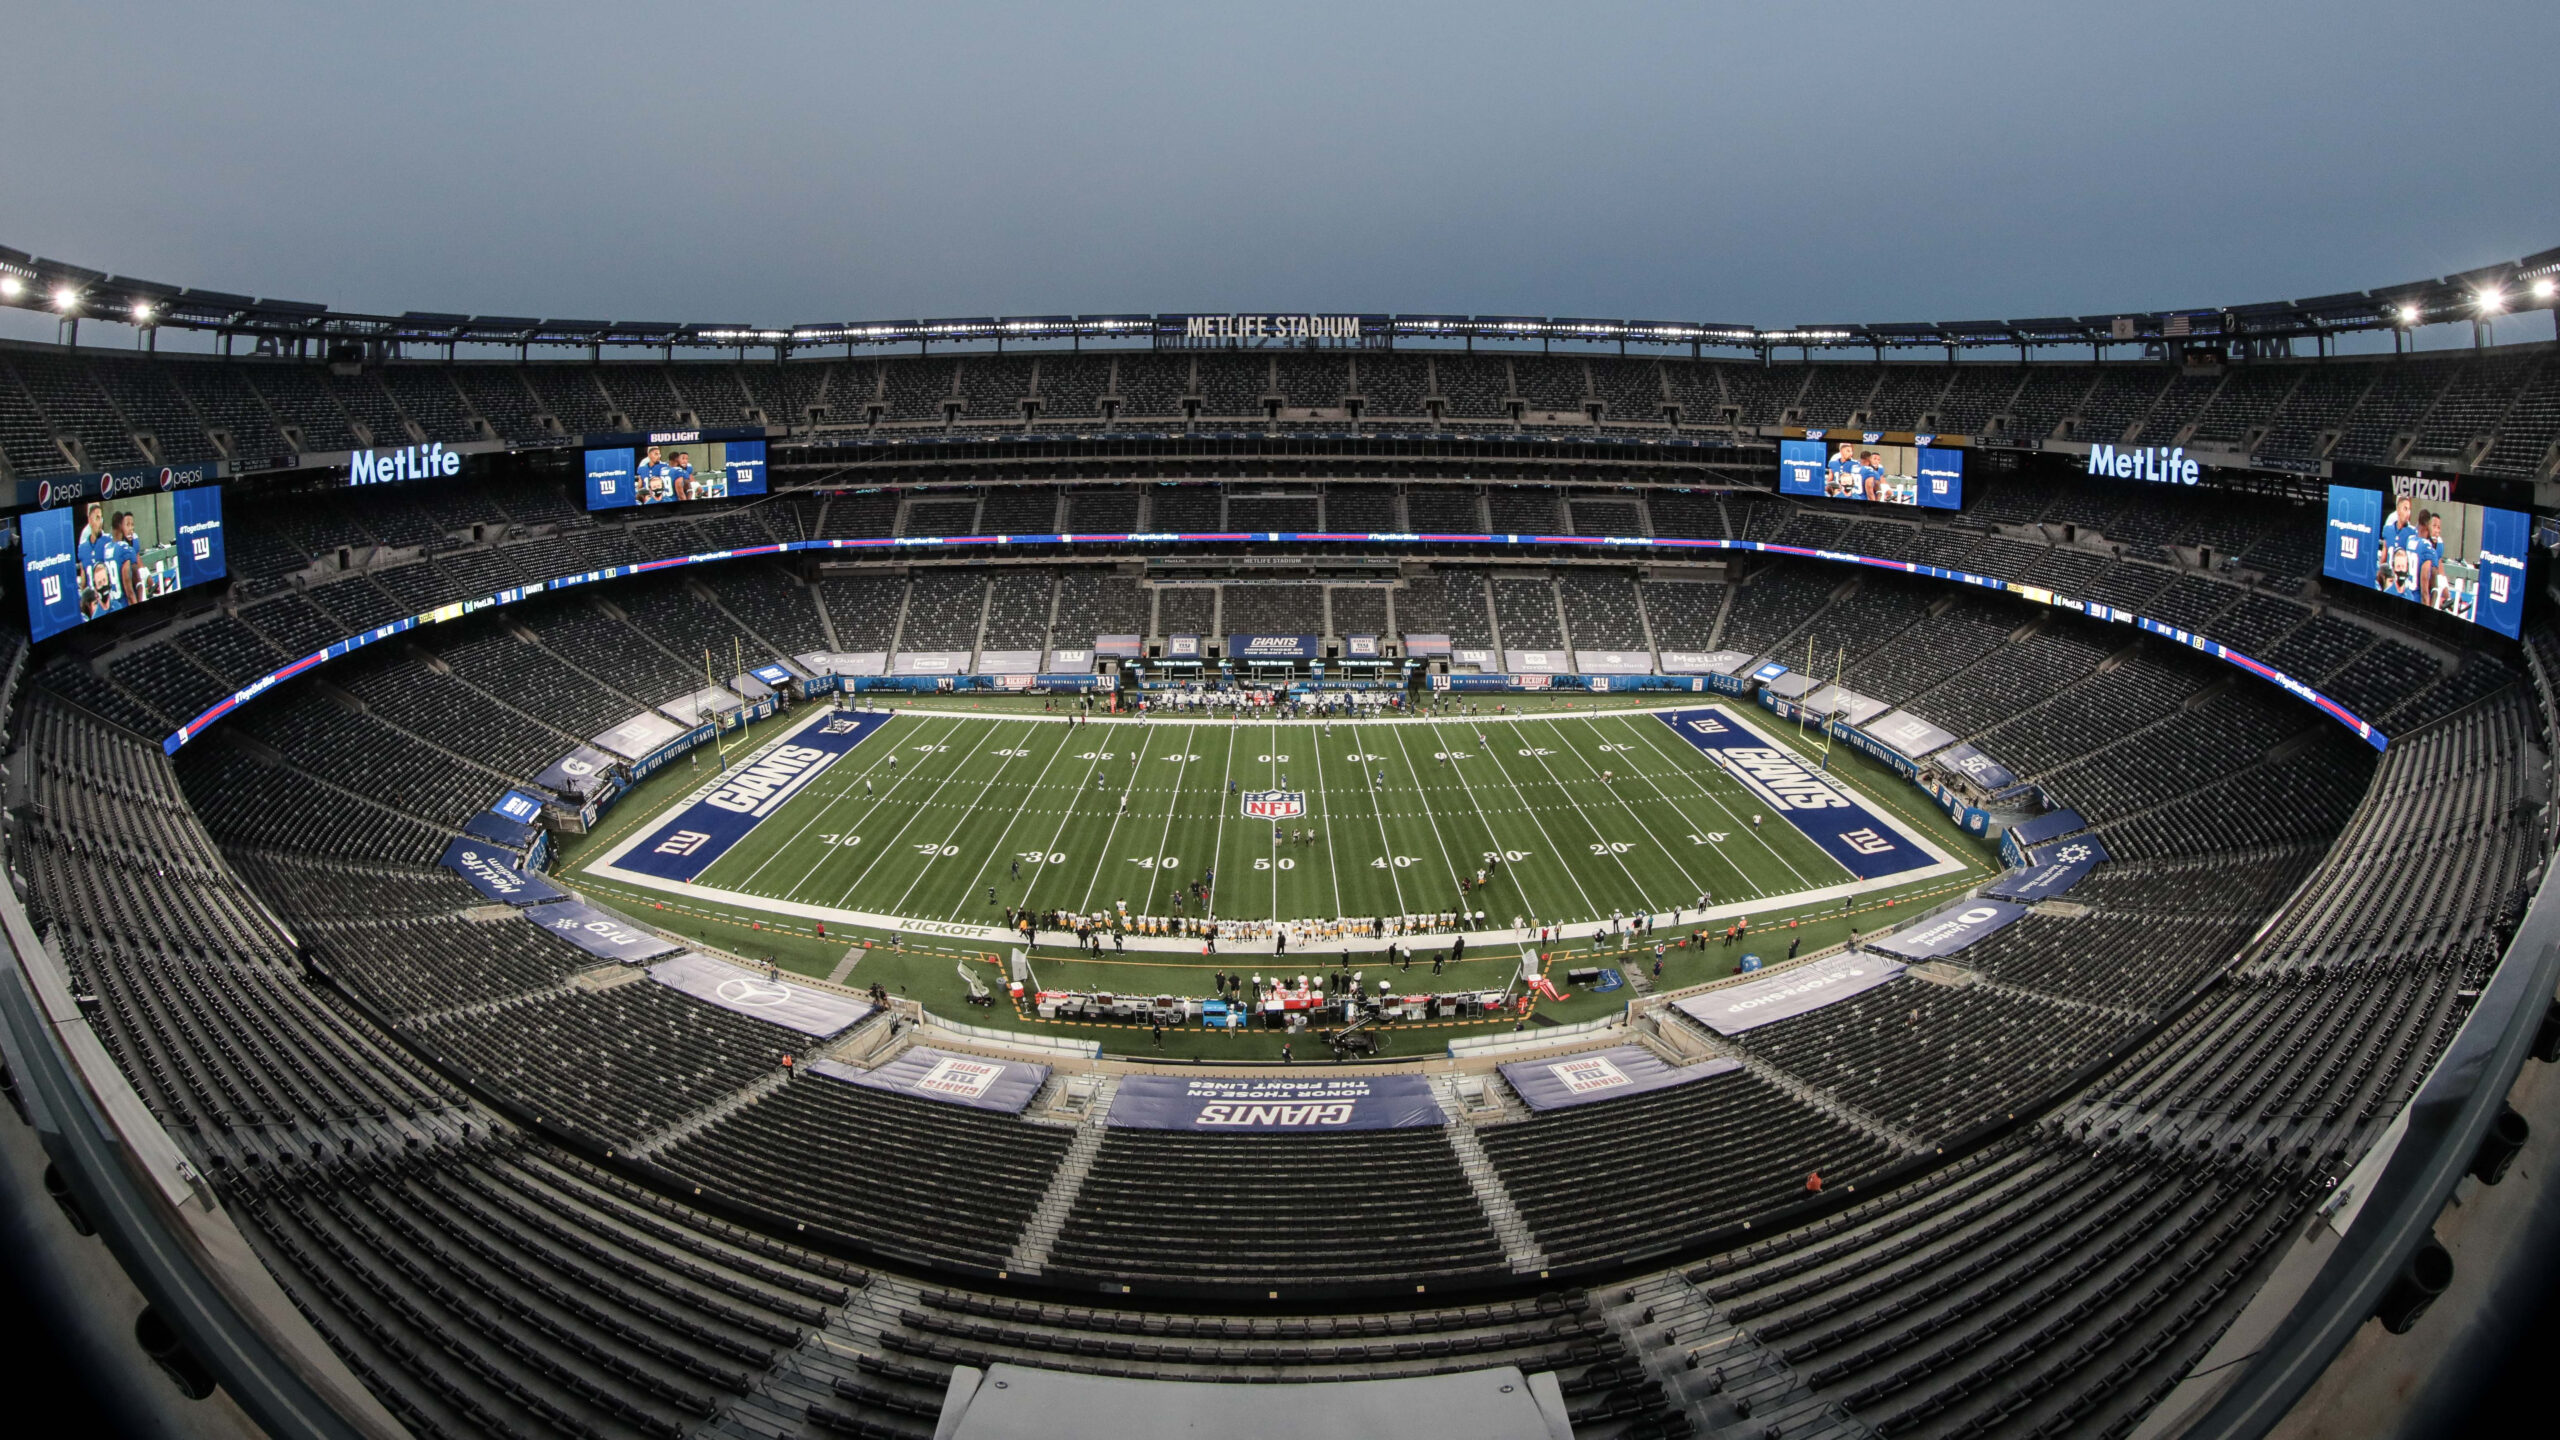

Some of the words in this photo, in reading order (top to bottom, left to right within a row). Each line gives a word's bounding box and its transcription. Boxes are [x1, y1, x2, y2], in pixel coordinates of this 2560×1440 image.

[1187, 316, 1268, 338] METLIFE
[1275, 316, 1360, 338] STADIUM
[650, 432, 671, 442] BUD
[672, 431, 700, 442] LIGHT
[1806, 430, 1823, 440] SAP
[1863, 433, 1880, 442] SAP
[1914, 436, 1932, 446] SAP
[351, 442, 460, 486] MetLife
[2089, 444, 2199, 486] MetLife
[173, 467, 203, 488] pepsi
[53, 480, 82, 506] pepsi
[114, 472, 144, 499] pepsi
[2392, 471, 2450, 502] verizon
[179, 520, 220, 534] #TogetherBlue
[2330, 518, 2372, 534] #TogetherBlue
[27, 553, 71, 572] #TogetherBlue
[2480, 550, 2524, 570] #TogetherBlue
[1250, 637, 1298, 646] GIANTS
[1672, 654, 1734, 663] MetLife
[1432, 676, 1450, 690] ny
[1521, 676, 1546, 685] KICKOFF
[759, 702, 772, 720] ny
[1776, 702, 1788, 718] ny
[1834, 726, 1848, 739] NEW
[1850, 735, 1864, 748] YORK
[1866, 742, 1892, 764] FOOTBALL
[636, 764, 646, 780] NEW
[648, 755, 662, 770] YORK
[664, 740, 692, 761] FOOTBALL
[1000, 749, 1031, 757] 20
[1083, 752, 1114, 760] 30
[1170, 754, 1201, 762] 40
[1258, 754, 1290, 763] 50
[1346, 754, 1380, 762] 40
[1786, 752, 1808, 766] END
[1808, 764, 1848, 791] RACISM
[1960, 756, 1987, 774] 5G
[695, 775, 730, 796] TAKES
[706, 744, 824, 813] GIANTS
[1722, 748, 1850, 809] GIANTS
[586, 804, 597, 828] ny
[1248, 802, 1300, 816] NFL
[1952, 802, 1964, 826] ny
[654, 830, 712, 856] ny
[823, 834, 862, 847] 10
[1686, 832, 1725, 845] 10
[1838, 828, 1896, 855] ny
[919, 843, 960, 857] 20
[1589, 842, 1628, 856] 20
[1025, 852, 1066, 864] 30
[1137, 856, 1179, 869] 40
[1253, 858, 1296, 870] 50
[1370, 856, 1413, 869] 40
[461, 850, 521, 894] MetLife
[487, 856, 526, 886] Stadium
[584, 921, 640, 946] nrg
[899, 920, 992, 936] KICKOFF
[1924, 924, 1970, 946] United
[950, 1062, 992, 1075] PRIDE
[1562, 1058, 1597, 1072] PRIDE
[940, 1070, 977, 1084] ny
[1572, 1067, 1604, 1081] ny
[924, 1080, 979, 1097] GIANTS
[1189, 1082, 1248, 1090] LINES
[1573, 1074, 1624, 1092] GIANTS
[1186, 1090, 1222, 1098] ON
[1230, 1090, 1292, 1098] THOSE
[1298, 1090, 1370, 1098] HONOR
[1196, 1104, 1355, 1126] GIANTS
